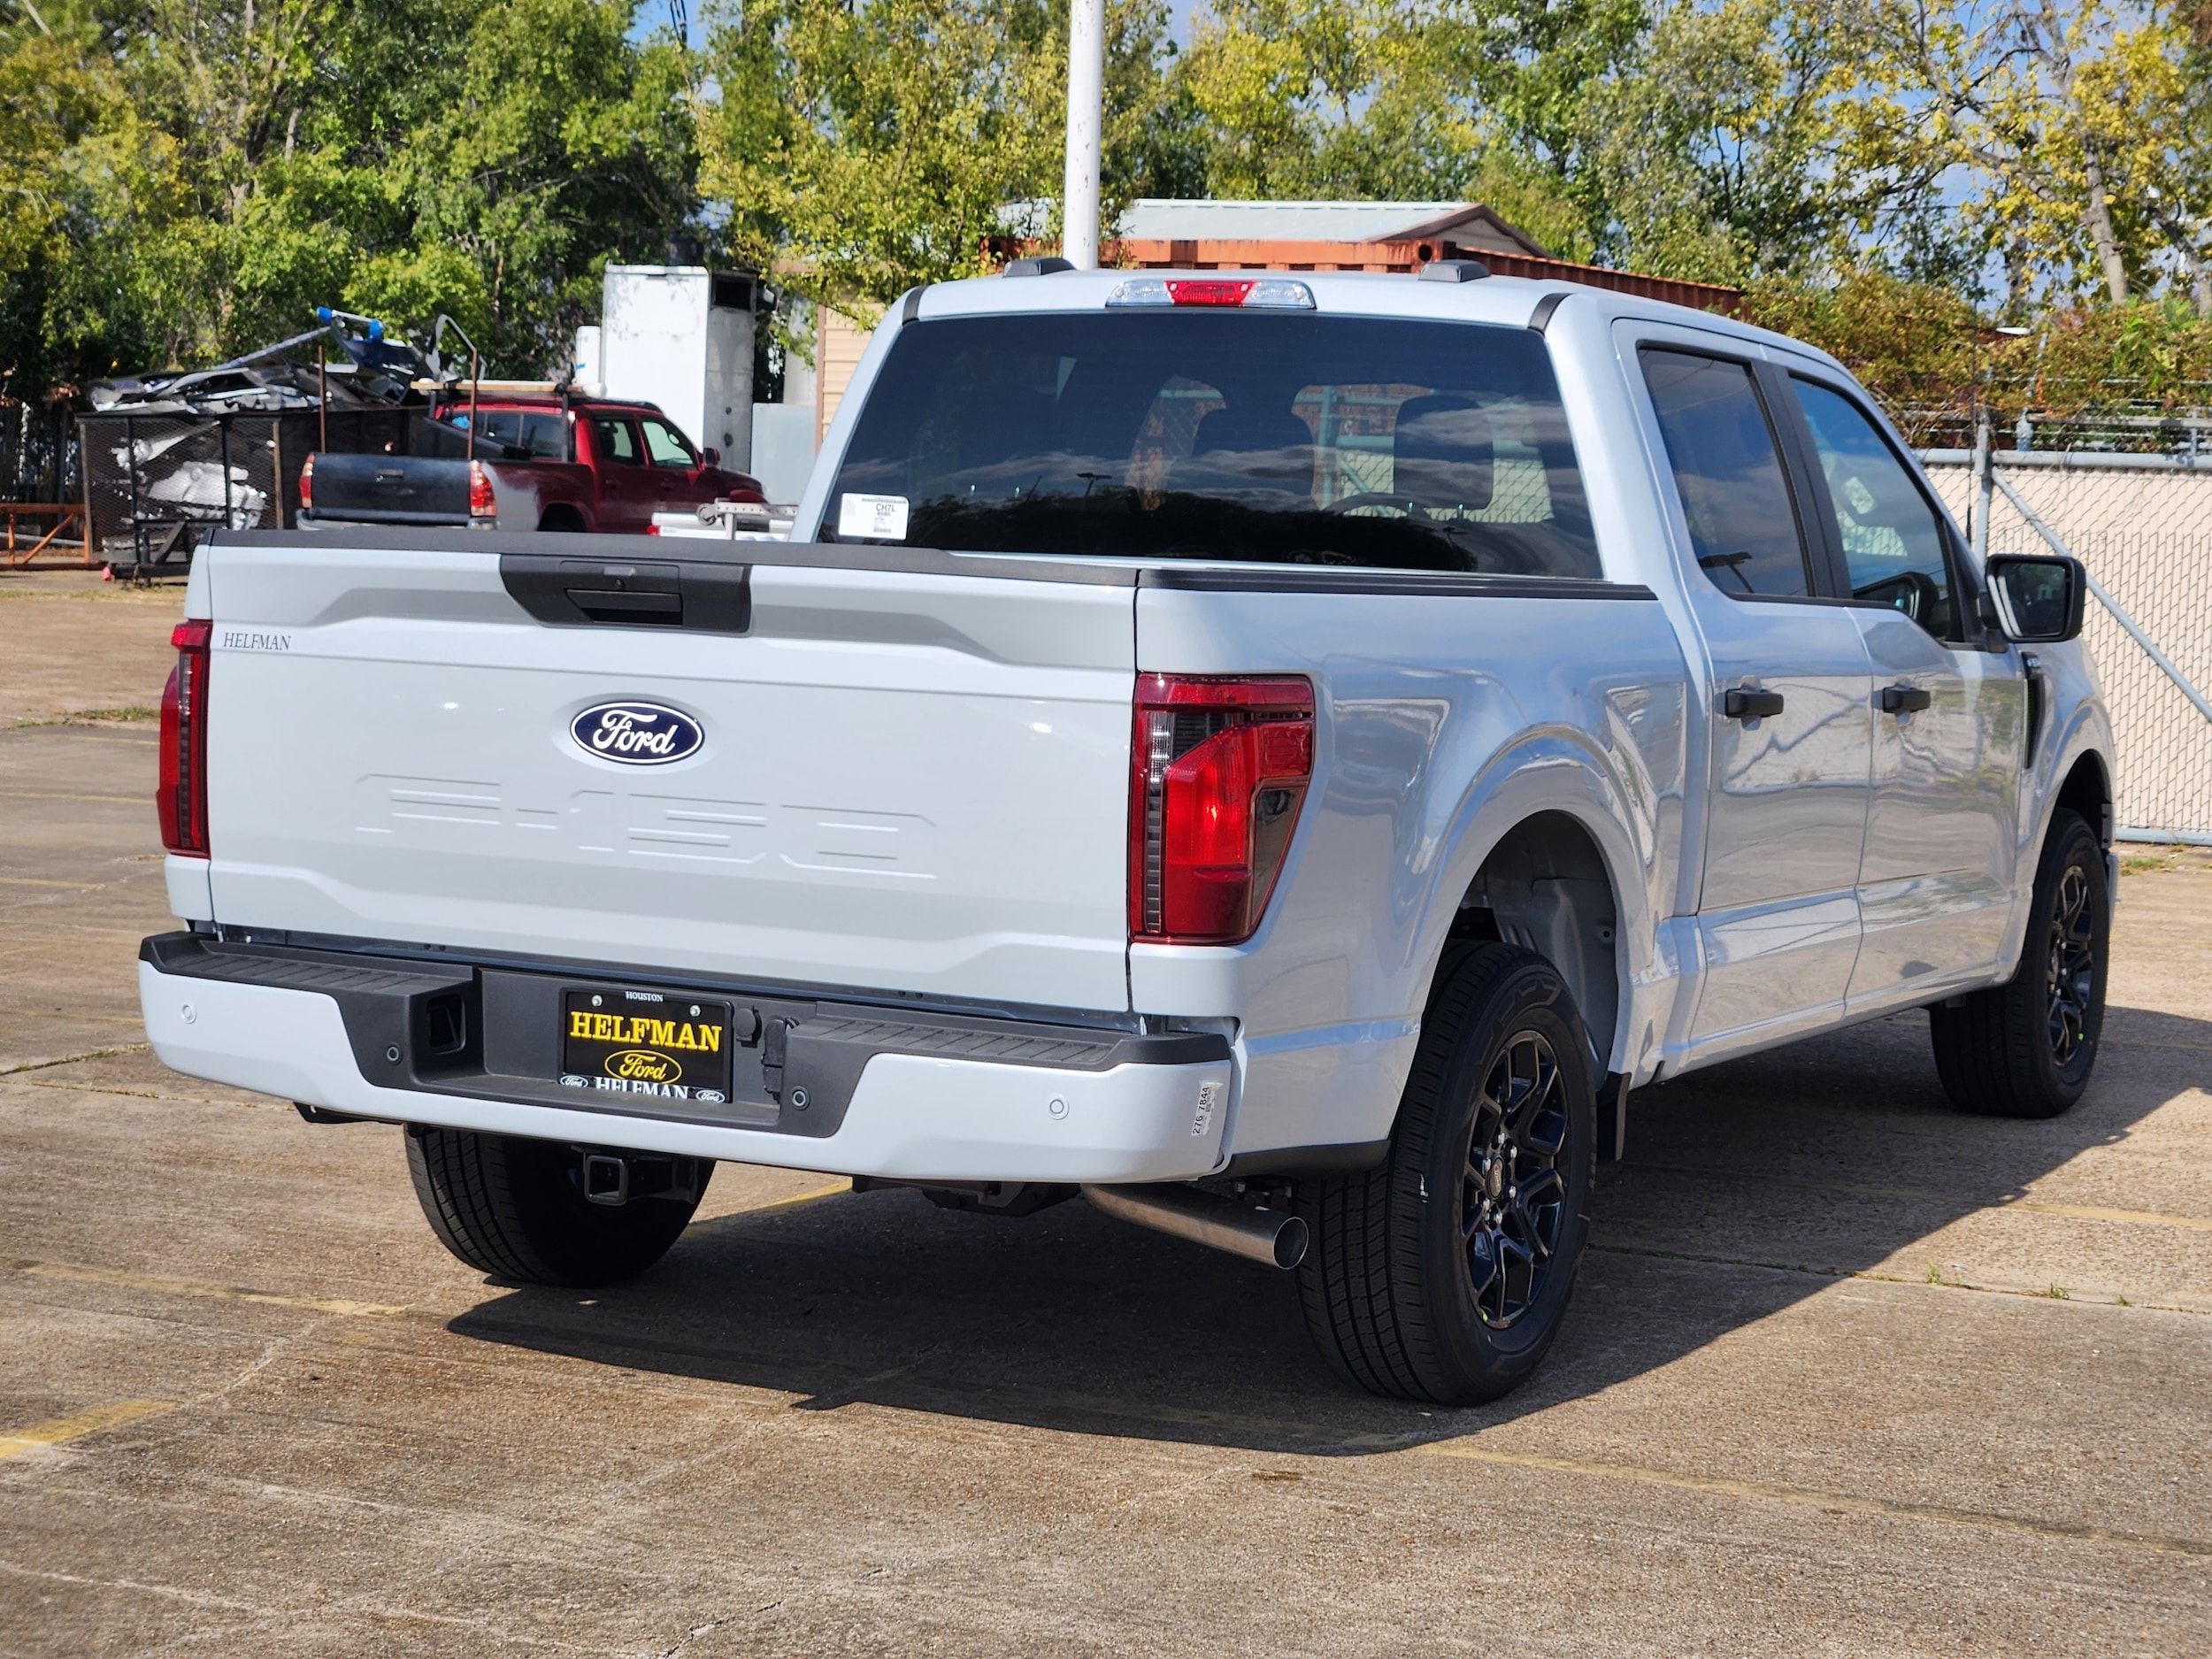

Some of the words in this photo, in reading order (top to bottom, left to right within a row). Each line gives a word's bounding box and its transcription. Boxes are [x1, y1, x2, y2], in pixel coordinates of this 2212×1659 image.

[223, 632, 292, 650] HELFMAN
[592, 709, 679, 755] Ford
[625, 990, 664, 1002] HOUSTON
[569, 1010, 723, 1053] HELFMAN
[618, 1053, 668, 1080] Ford
